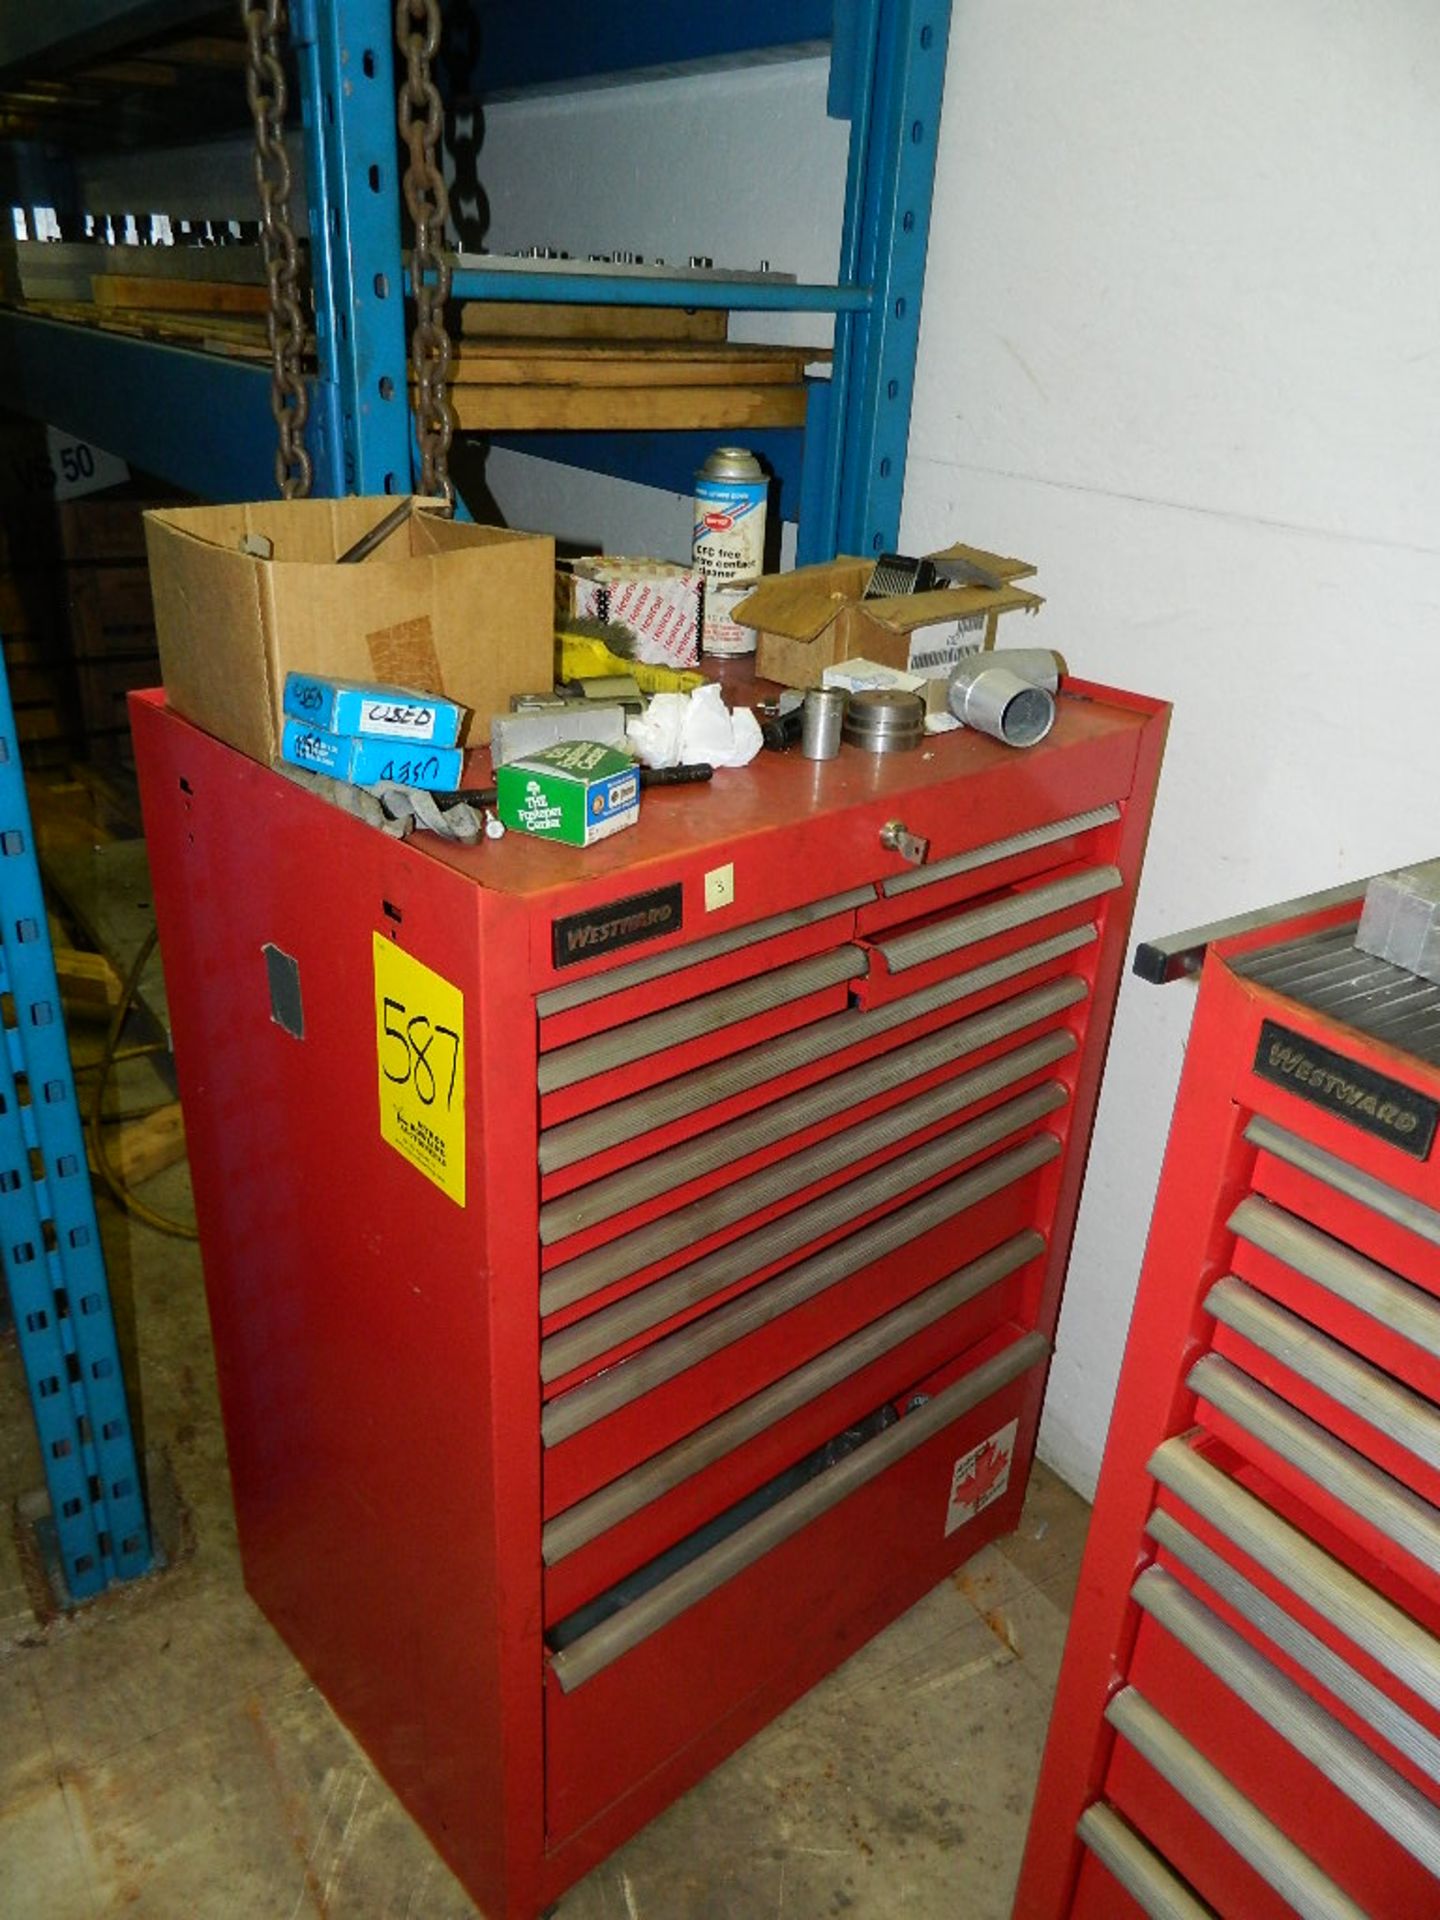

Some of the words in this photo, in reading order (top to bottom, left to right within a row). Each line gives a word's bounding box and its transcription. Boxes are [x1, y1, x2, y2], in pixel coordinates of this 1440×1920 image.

[60, 444, 94, 483] 50
[718, 549, 742, 560] free
[368, 704, 432, 726] USED
[380, 756, 439, 785] USED
[517, 806, 563, 822] Fastener
[567, 904, 673, 952] WESTWARD
[383, 997, 459, 1112] 587
[1268, 1040, 1418, 1133] WESTWARD
